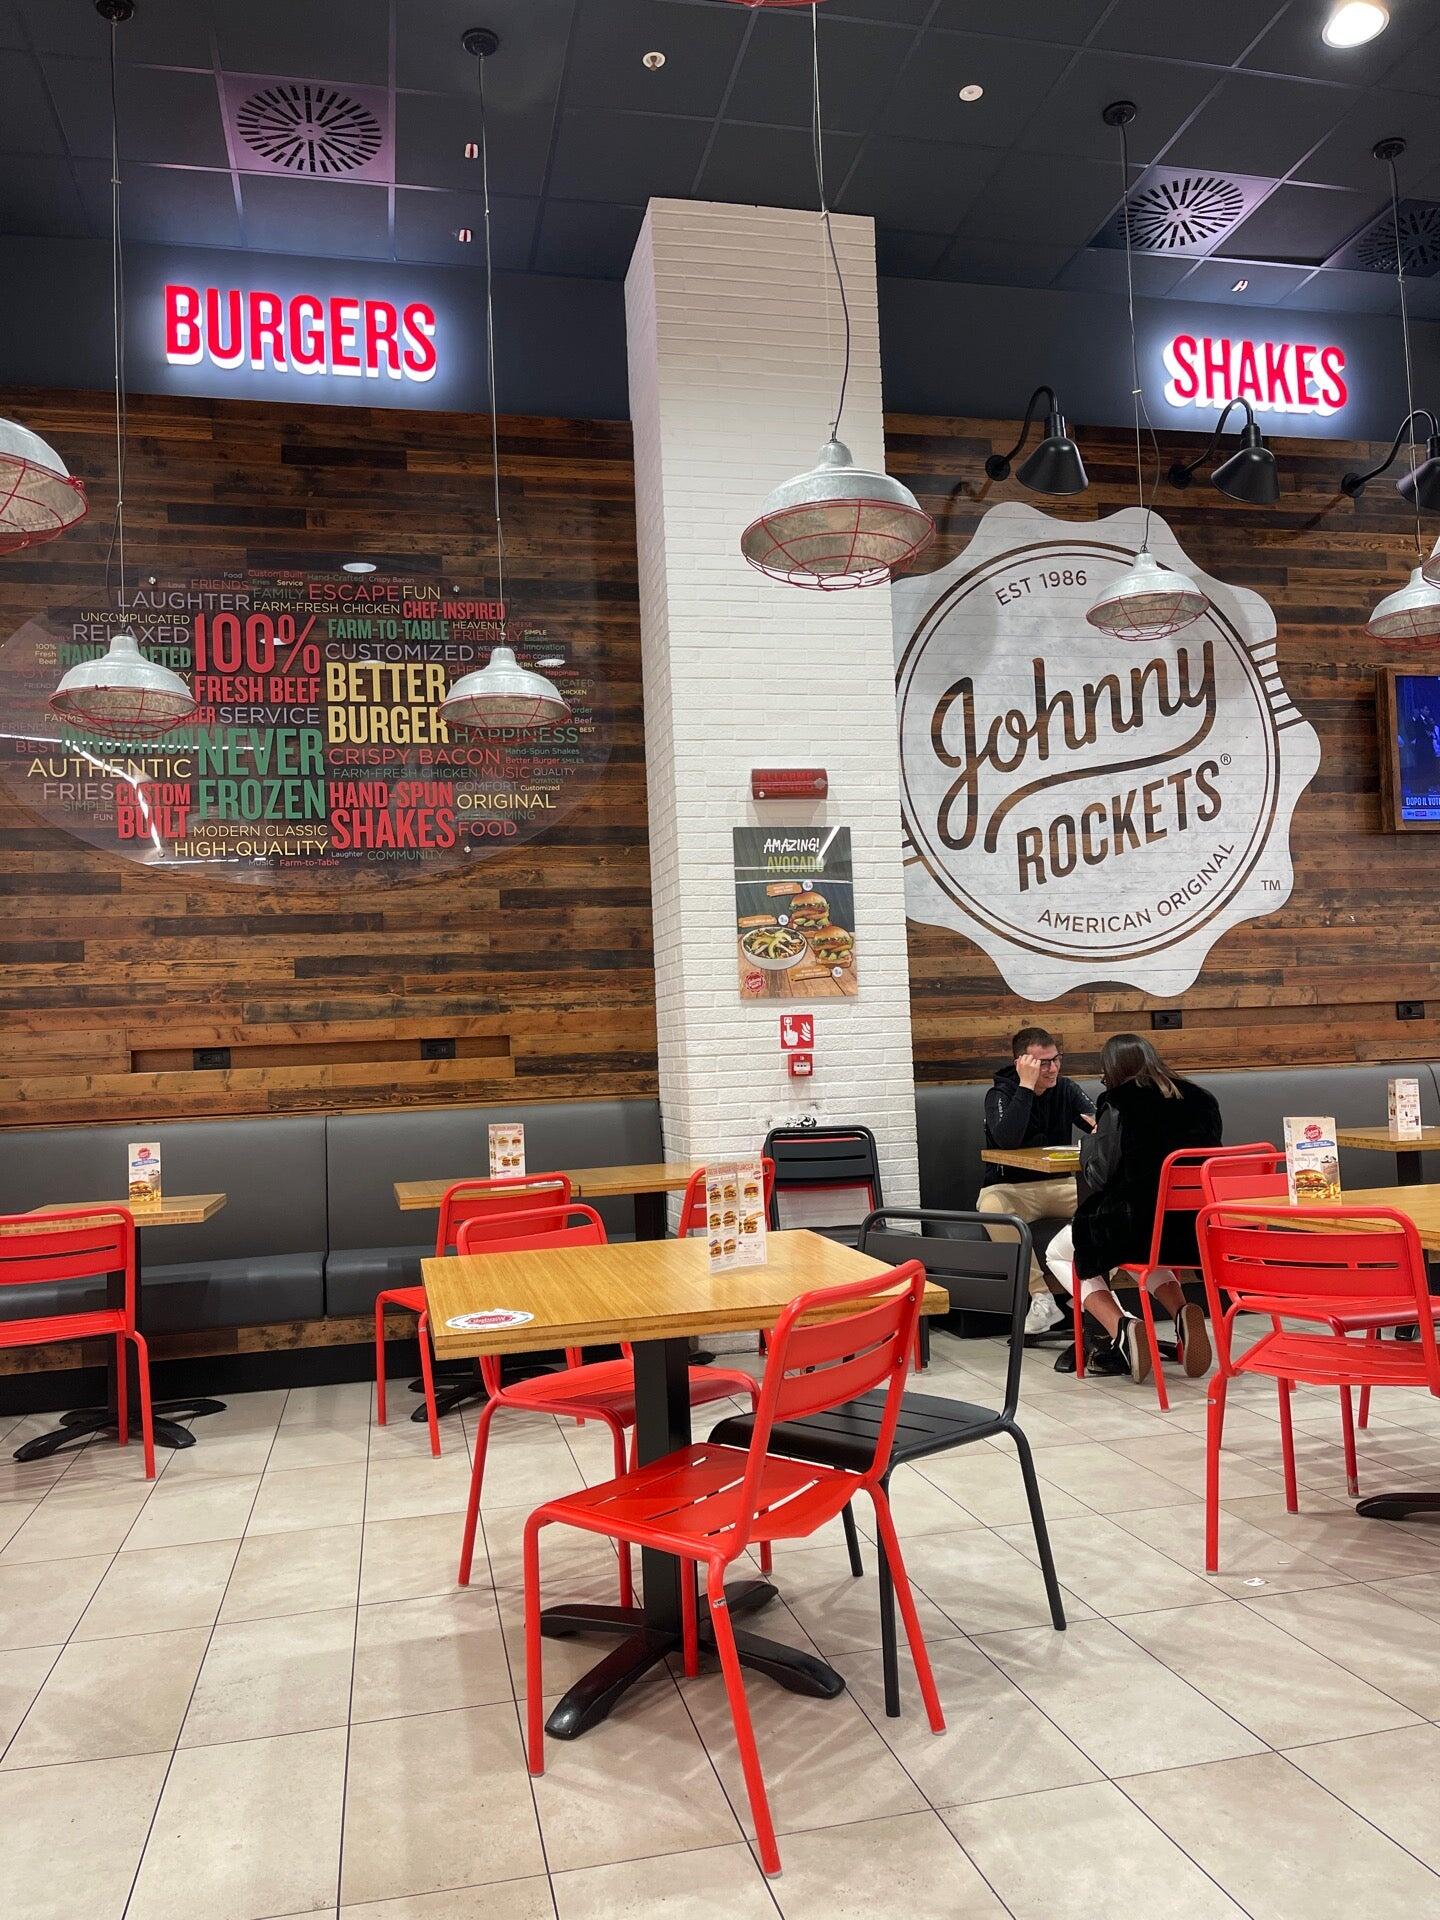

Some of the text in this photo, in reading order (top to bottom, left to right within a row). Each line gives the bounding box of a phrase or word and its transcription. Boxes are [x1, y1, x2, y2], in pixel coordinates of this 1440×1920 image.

[165, 284, 437, 382] BURGERS
[1163, 334, 1348, 417] SHAKES
[223, 571, 243, 579] Food
[248, 569, 303, 578] Custom Built
[307, 573, 364, 582] Hand-Crafted
[368, 576, 415, 584] Crispy Bacon
[191, 579, 249, 590] FRIENDS
[276, 580, 304, 588] Service
[995, 570, 1087, 606] EST 1986
[253, 588, 304, 600] FAMILY
[308, 583, 400, 602] ESCAPE
[403, 585, 441, 600] FUN
[117, 590, 250, 611] LAUGHTER
[253, 601, 400, 614] FARM-FRESH CHICKEN
[402, 600, 506, 620] CHEF-INSPIRED
[81, 612, 190, 625] UNCOMPLICATED
[452, 621, 506, 631] HEAVENLY
[73, 624, 190, 644] RELAXED
[327, 618, 450, 641] FARM-TO-TABLE
[453, 629, 521, 641] FRIENDLY
[194, 612, 321, 675] 100%
[523, 643, 566, 651] Innovation
[325, 643, 474, 661] CUSTOMIZED
[194, 675, 264, 703] FRESH
[269, 676, 320, 703] BEEF
[326, 661, 450, 744] BETTER BURGER
[44, 713, 83, 723] FARMS
[219, 706, 321, 724] SERVICE
[454, 727, 579, 744] HAPPINESS
[16, 740, 58, 753] BEST
[505, 747, 580, 756] Hand-Spun Shakes
[931, 640, 1216, 853] Johnny
[328, 748, 501, 766] CRISPY BACON
[533, 757, 560, 766] Burger
[27, 757, 192, 779] AUTHENTIC
[198, 728, 326, 820] NEVER FROZEN
[333, 768, 478, 779] FARM-FRESH CHICKEN
[481, 766, 531, 779] MUSIC
[533, 768, 576, 777] QUALITY
[43, 783, 114, 800] FRIES
[455, 781, 519, 792] COMFORT
[63, 800, 114, 812] SIMPLE
[456, 793, 557, 810] ORIGINAL
[1428, 797, 1440, 805] VOT
[93, 813, 113, 821] FUN
[115, 782, 191, 839] CUSTOM BUILT
[329, 781, 456, 850] HAND-SPUN SHAKES
[193, 824, 328, 838] MODERN CLASSIC
[458, 820, 518, 838] FOOD
[1017, 758, 1221, 892] ROCKETS
[174, 840, 329, 857] HIGH-QUALITY
[763, 837, 820, 853] AMAZING!
[248, 858, 274, 867] MUSIC
[279, 859, 340, 867] Farm-to-Table
[331, 851, 364, 860] Laughter
[367, 849, 444, 862] COMMUNITY
[767, 855, 825, 873] AVOCADO
[1037, 843, 1235, 934] AMERICAN ORIGINAL
[1261, 880, 1280, 891] TM
